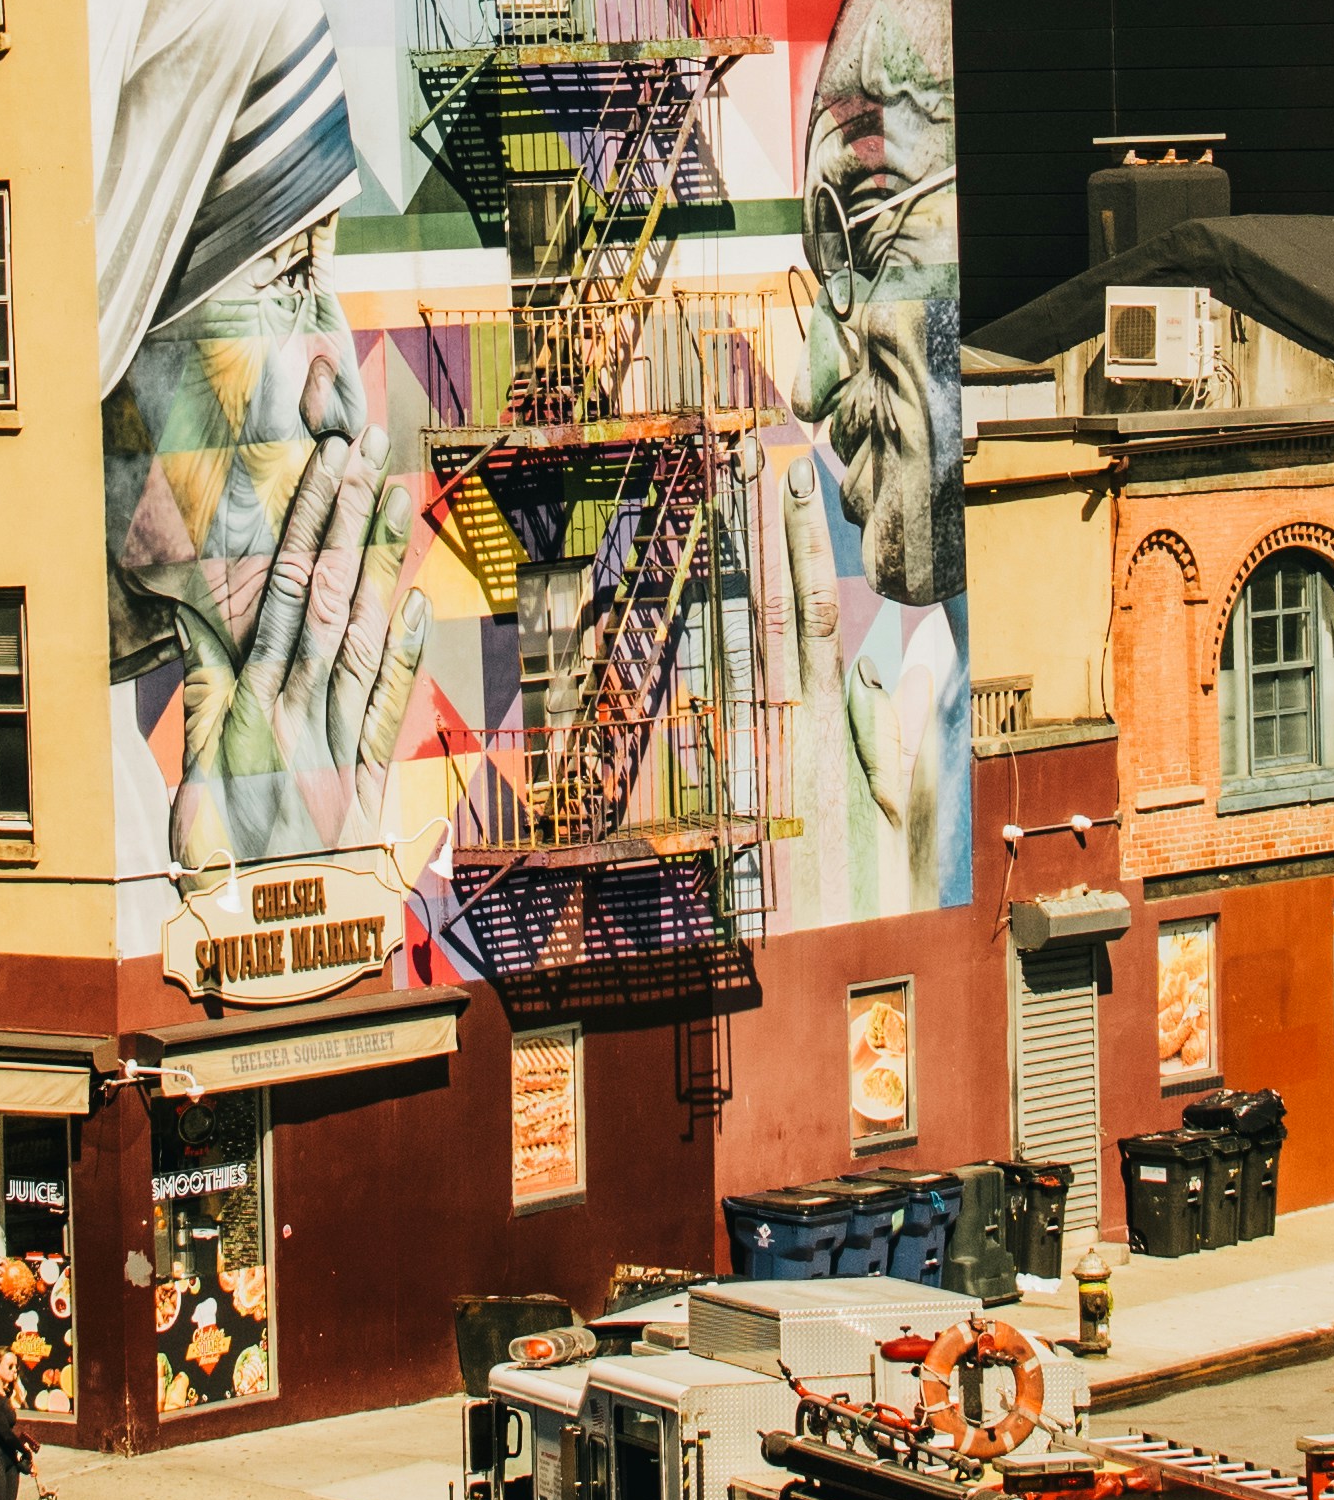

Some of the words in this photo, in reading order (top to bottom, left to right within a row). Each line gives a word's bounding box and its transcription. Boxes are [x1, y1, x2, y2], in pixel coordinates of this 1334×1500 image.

[252, 876, 327, 925] CHELSEA
[195, 929, 286, 987] SQUARE
[290, 915, 386, 974] MARKET
[231, 1048, 291, 1075] CHELSEA
[294, 1040, 342, 1065] SQUARE
[344, 1031, 396, 1057] MARKET
[5, 1179, 58, 1203] JUICE
[151, 1163, 248, 1200] SMOOTHIES
